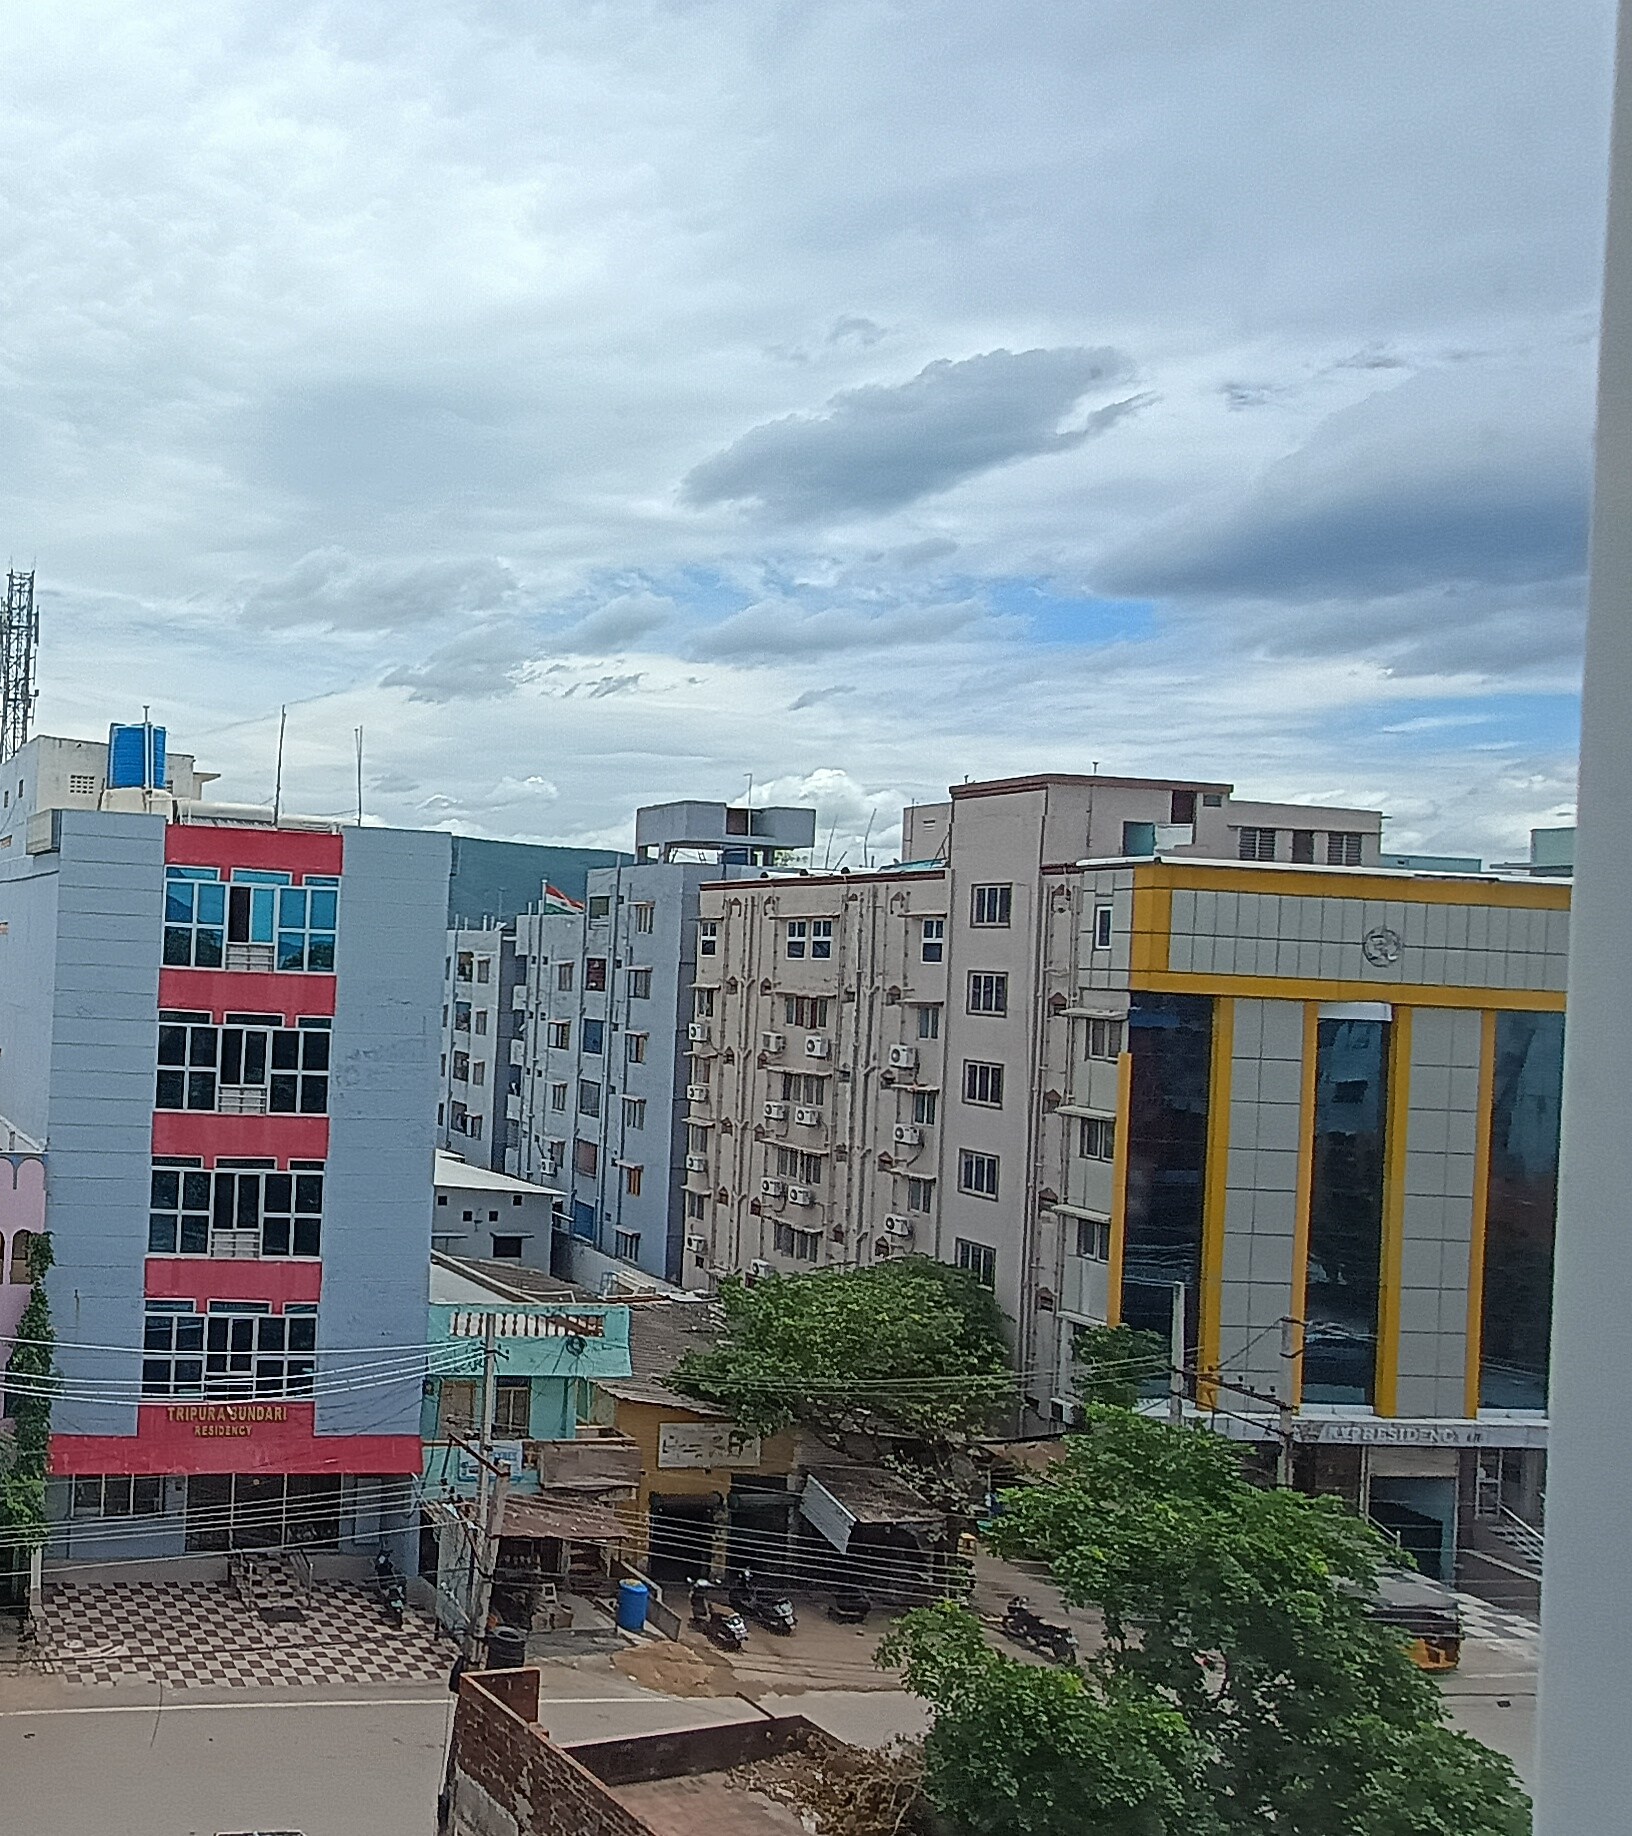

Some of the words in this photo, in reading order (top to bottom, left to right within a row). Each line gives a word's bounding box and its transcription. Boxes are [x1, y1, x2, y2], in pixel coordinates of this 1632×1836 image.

[168, 1406, 226, 1421] TRIPURA
[230, 1406, 287, 1421] SUNDARI
[194, 1425, 252, 1437] RESIDENCY
